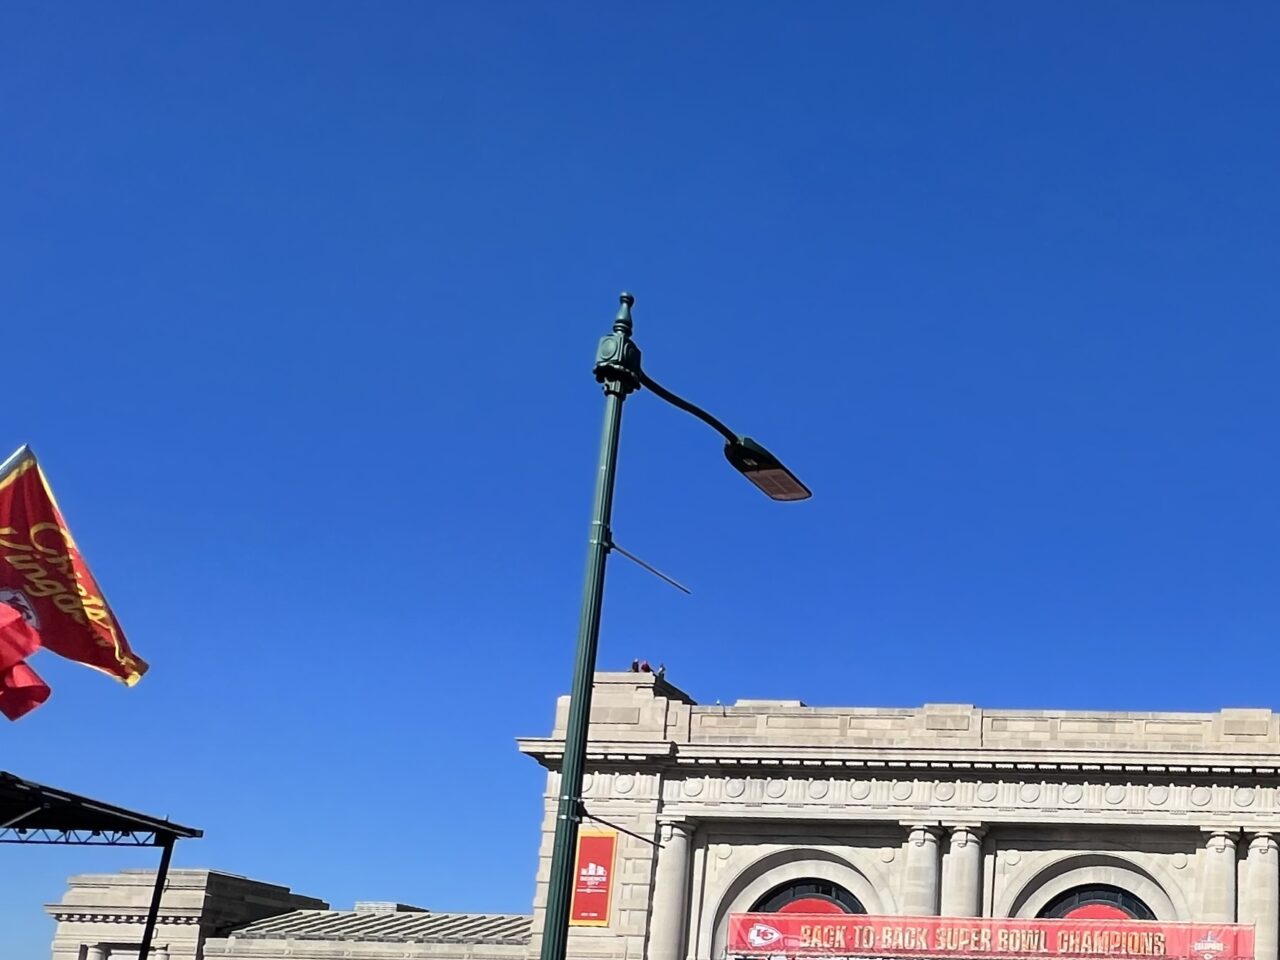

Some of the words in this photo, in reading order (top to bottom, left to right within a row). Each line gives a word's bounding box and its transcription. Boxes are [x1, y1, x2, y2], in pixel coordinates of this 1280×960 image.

[936, 928, 992, 951] SUPER
[997, 929, 1048, 952] BOWL
[1057, 932, 1167, 955] CHAMPIONS
